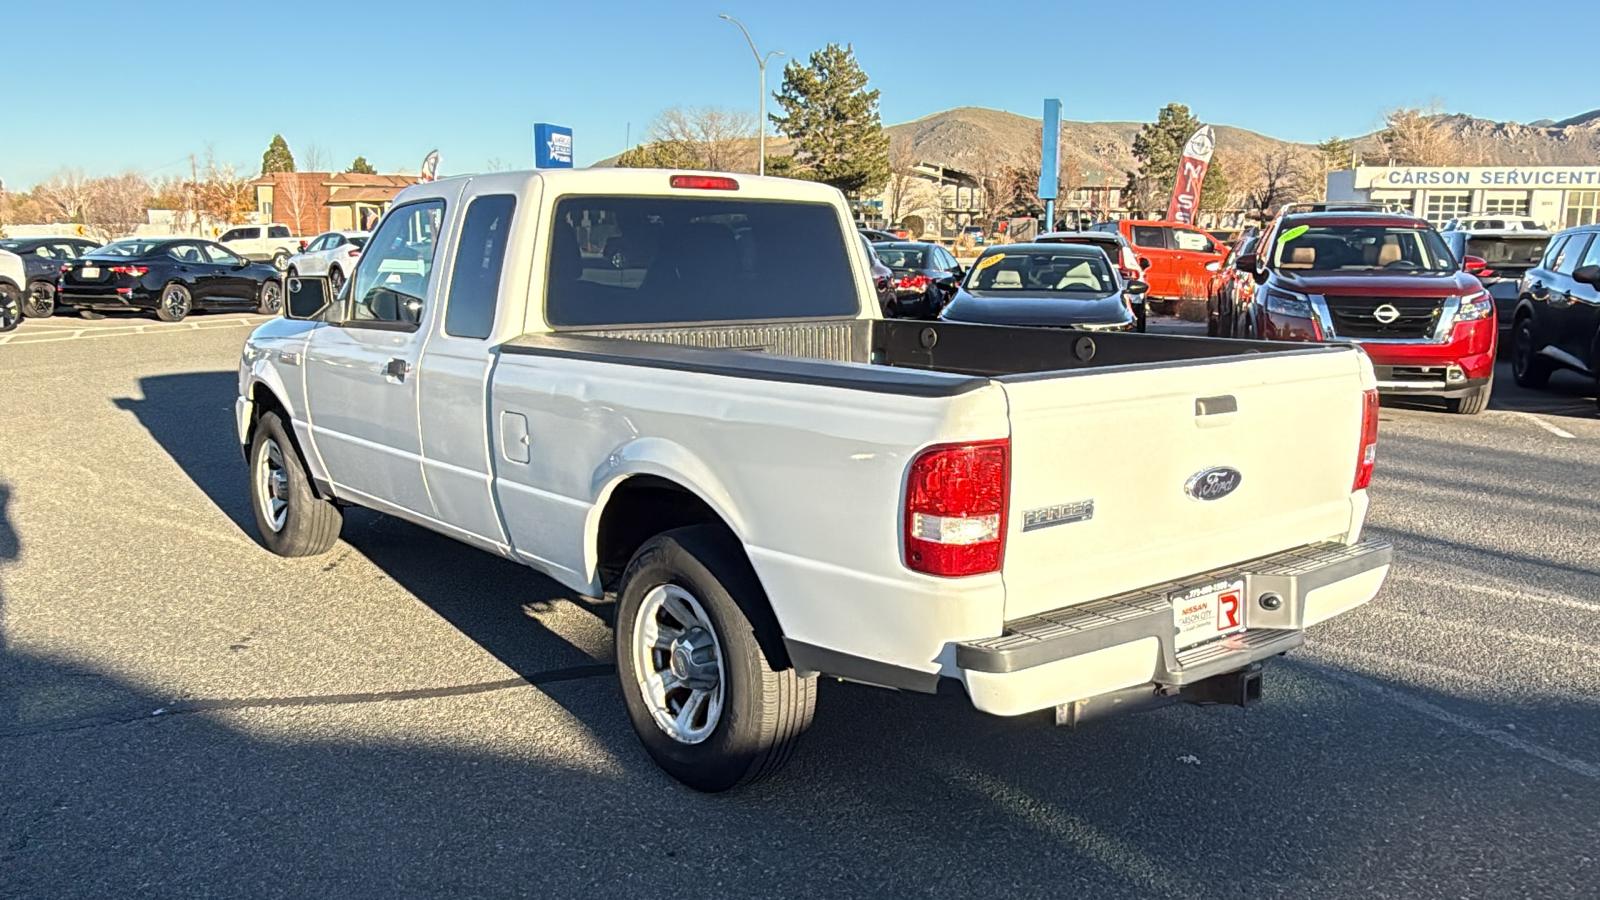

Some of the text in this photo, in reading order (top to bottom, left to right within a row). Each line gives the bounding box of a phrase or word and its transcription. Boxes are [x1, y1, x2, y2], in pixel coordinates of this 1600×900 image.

[1388, 170, 1470, 185] CARSON
[1202, 471, 1235, 496] Ford
[1025, 500, 1094, 525] RANGER
[1178, 609, 1212, 627] CARSON CITY
[1181, 602, 1208, 616] NISSAN
